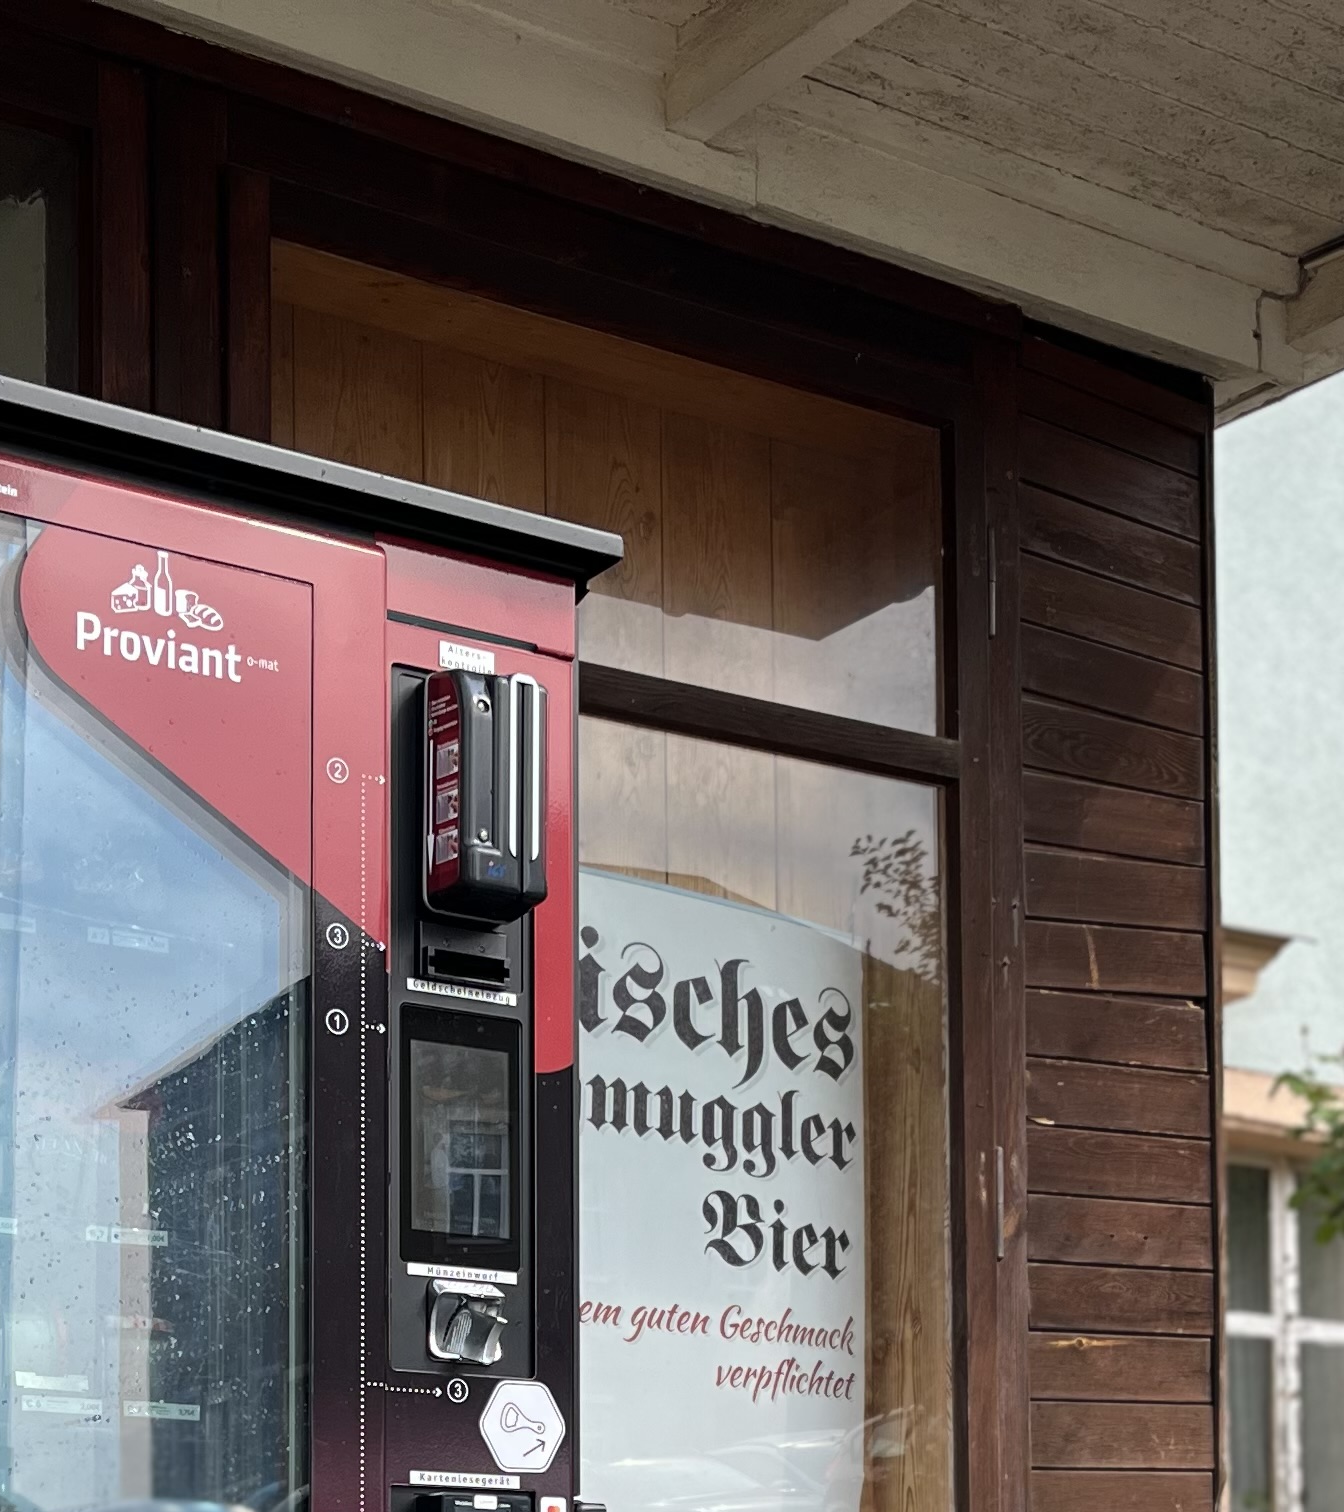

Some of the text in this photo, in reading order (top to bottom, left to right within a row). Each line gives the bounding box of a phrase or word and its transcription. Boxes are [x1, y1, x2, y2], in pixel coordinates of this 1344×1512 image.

[75, 609, 279, 683] Proviant o-mat
[702, 1189, 851, 1281] Bier
[427, 1265, 499, 1282] Münzeinwurf
[623, 1302, 711, 1343] guten
[719, 1304, 856, 1358] Geschmack
[715, 1357, 856, 1403] verpflichtet
[419, 1472, 511, 1487] Kartenlesegerät
